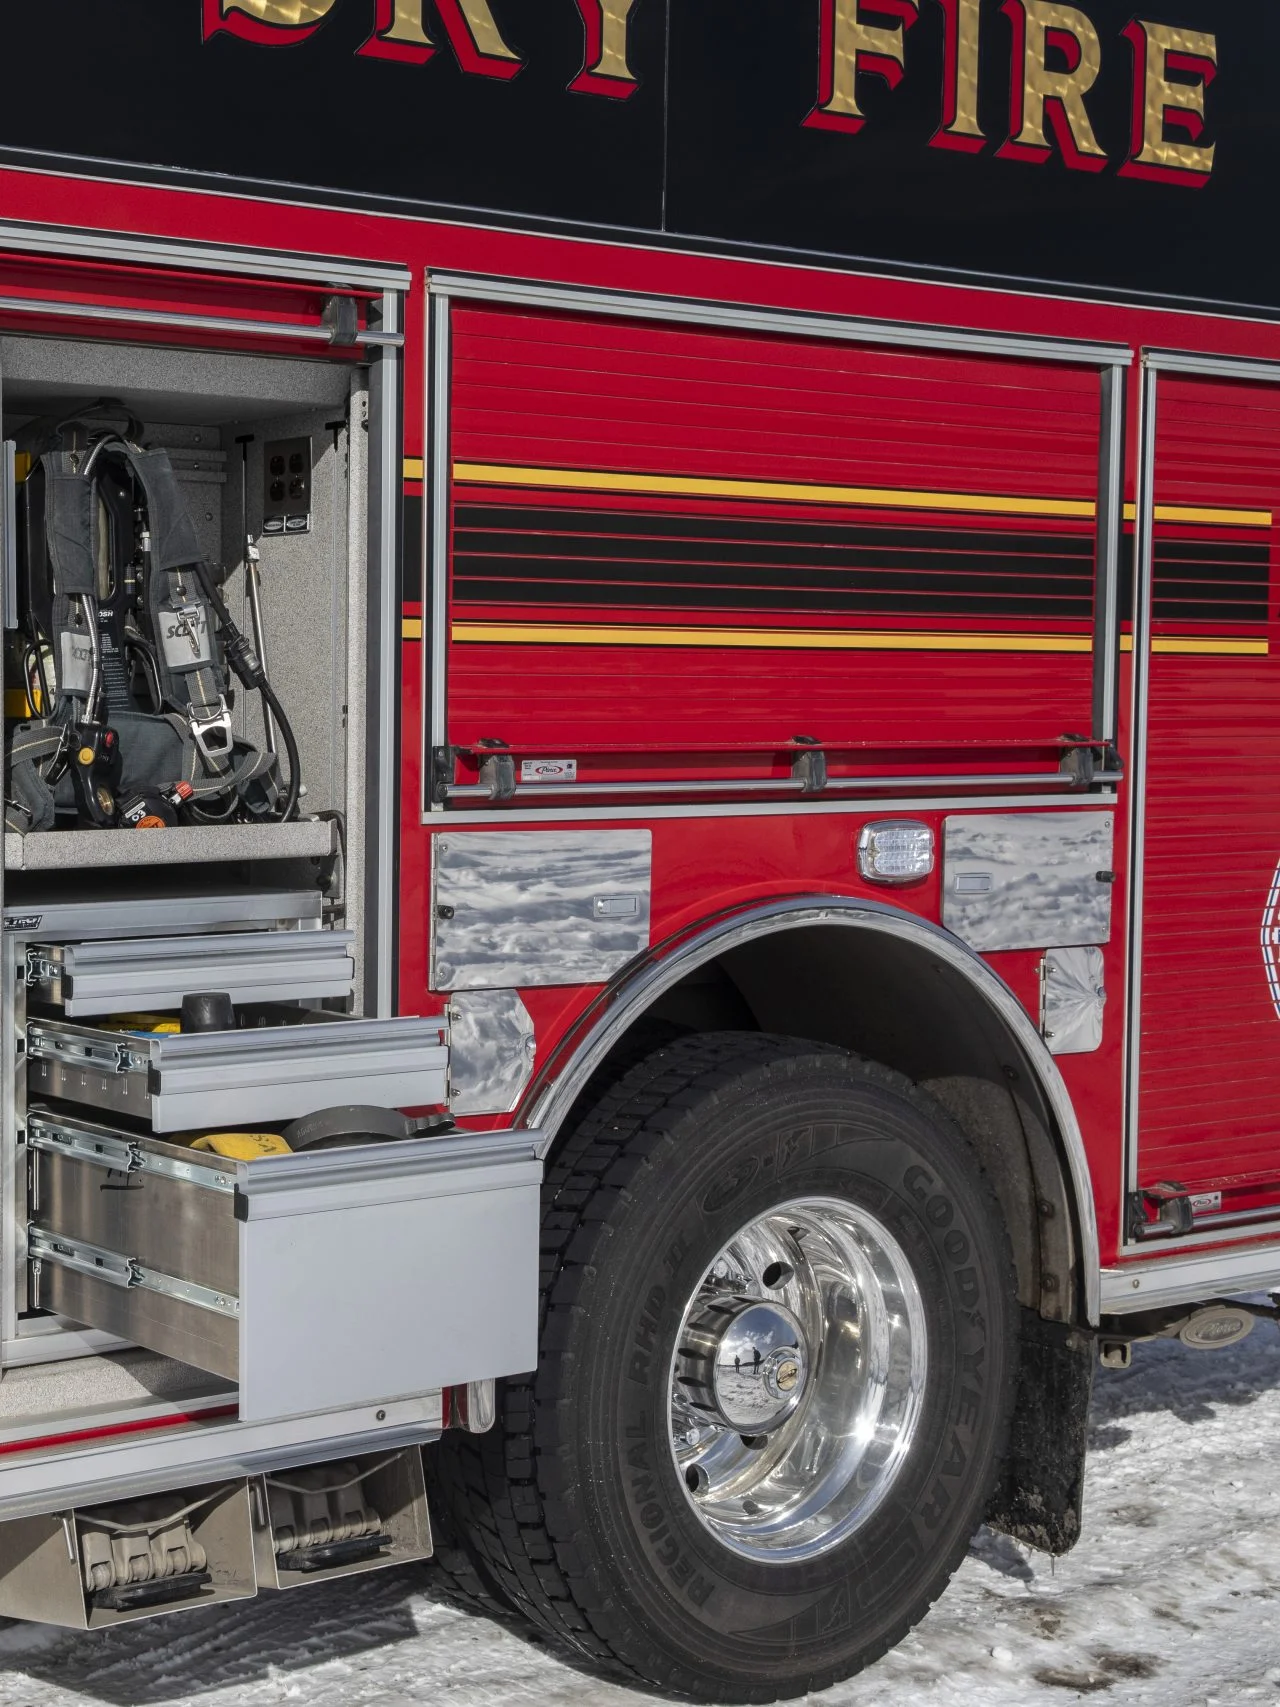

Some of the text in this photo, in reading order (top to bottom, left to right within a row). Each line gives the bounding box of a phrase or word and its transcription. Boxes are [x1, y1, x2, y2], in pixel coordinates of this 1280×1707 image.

[802, 0, 1218, 188] FIRE
[166, 620, 208, 639] SCT
[628, 1285, 671, 1388] RHD
[903, 1165, 987, 1530] GOODYEAR
[627, 1420, 715, 1608] REGIONAL
